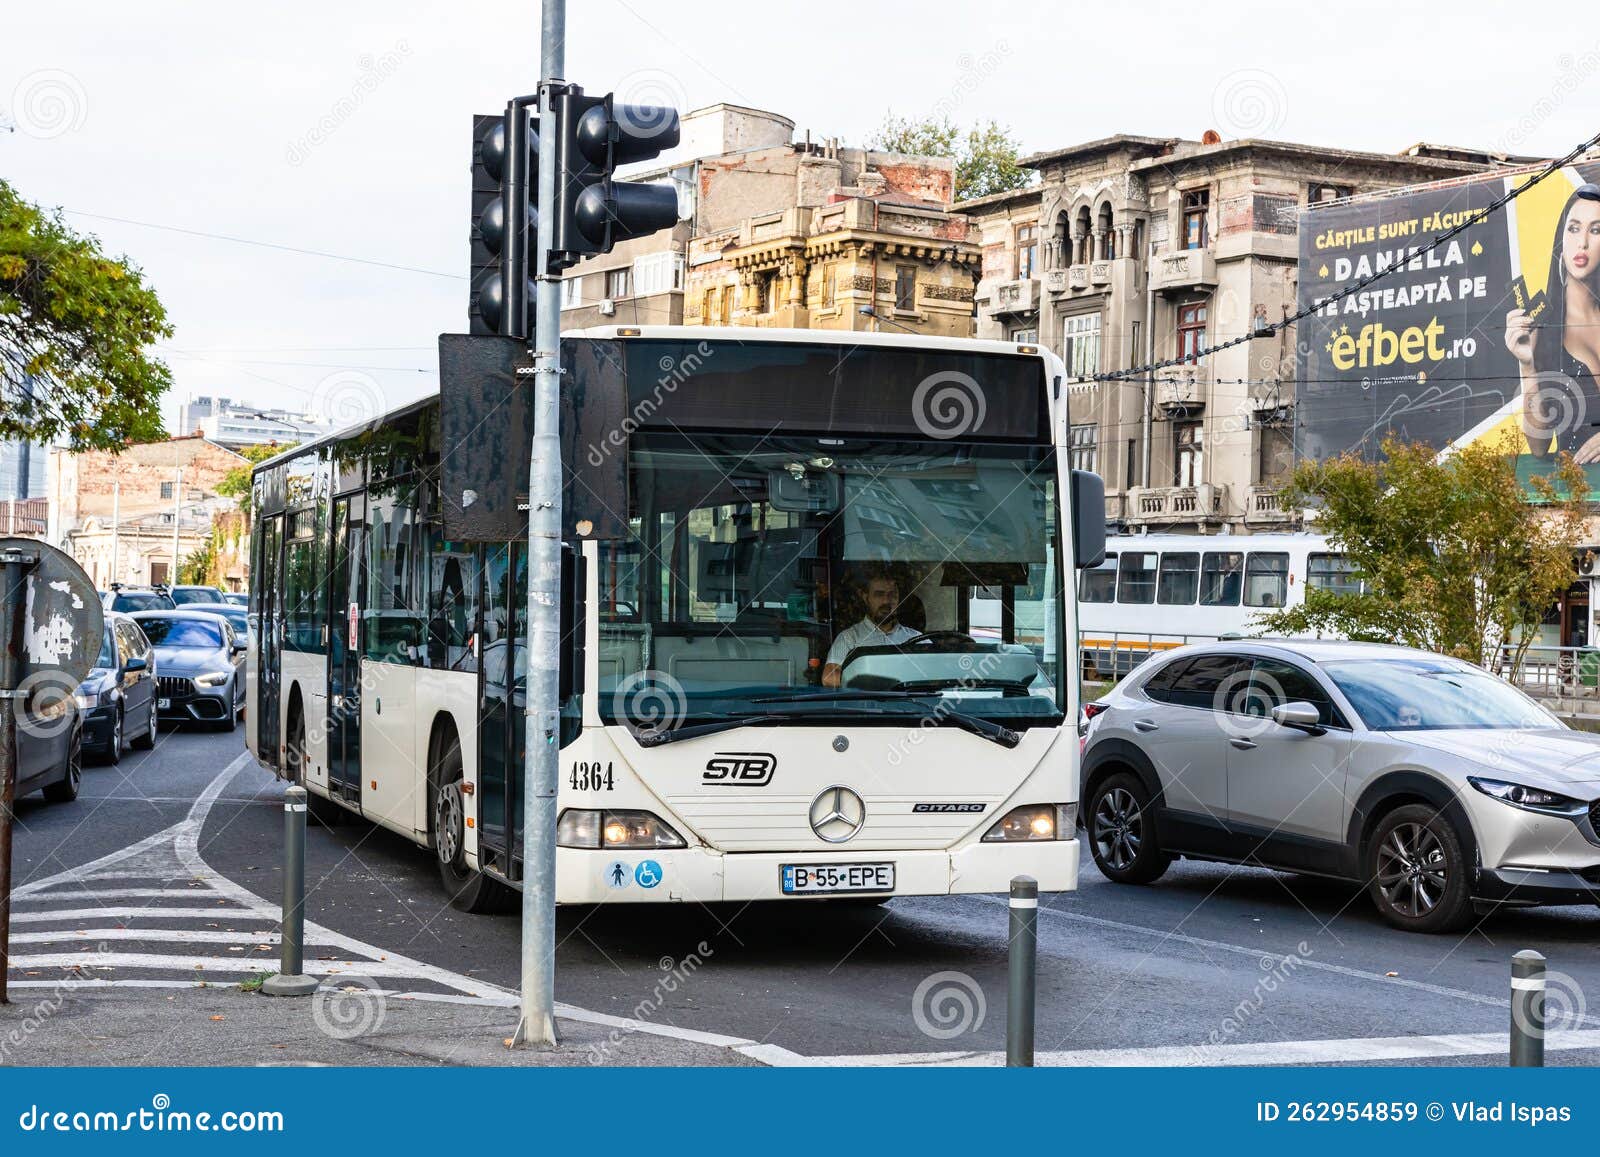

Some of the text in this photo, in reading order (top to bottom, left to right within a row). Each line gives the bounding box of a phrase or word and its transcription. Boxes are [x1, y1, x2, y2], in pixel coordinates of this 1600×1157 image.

[1315, 227, 1375, 250] CĂRȚILE
[1379, 219, 1418, 239] SUNT
[1335, 240, 1464, 282] DANIELA
[1343, 276, 1452, 319] AȘTEAPTĂ
[1459, 276, 1487, 300] PE
[569, 761, 614, 791] 4364
[702, 757, 770, 781] STB
[915, 804, 984, 812] CITARO
[784, 880, 793, 888] RO
[795, 867, 888, 887] B 55 EPE
